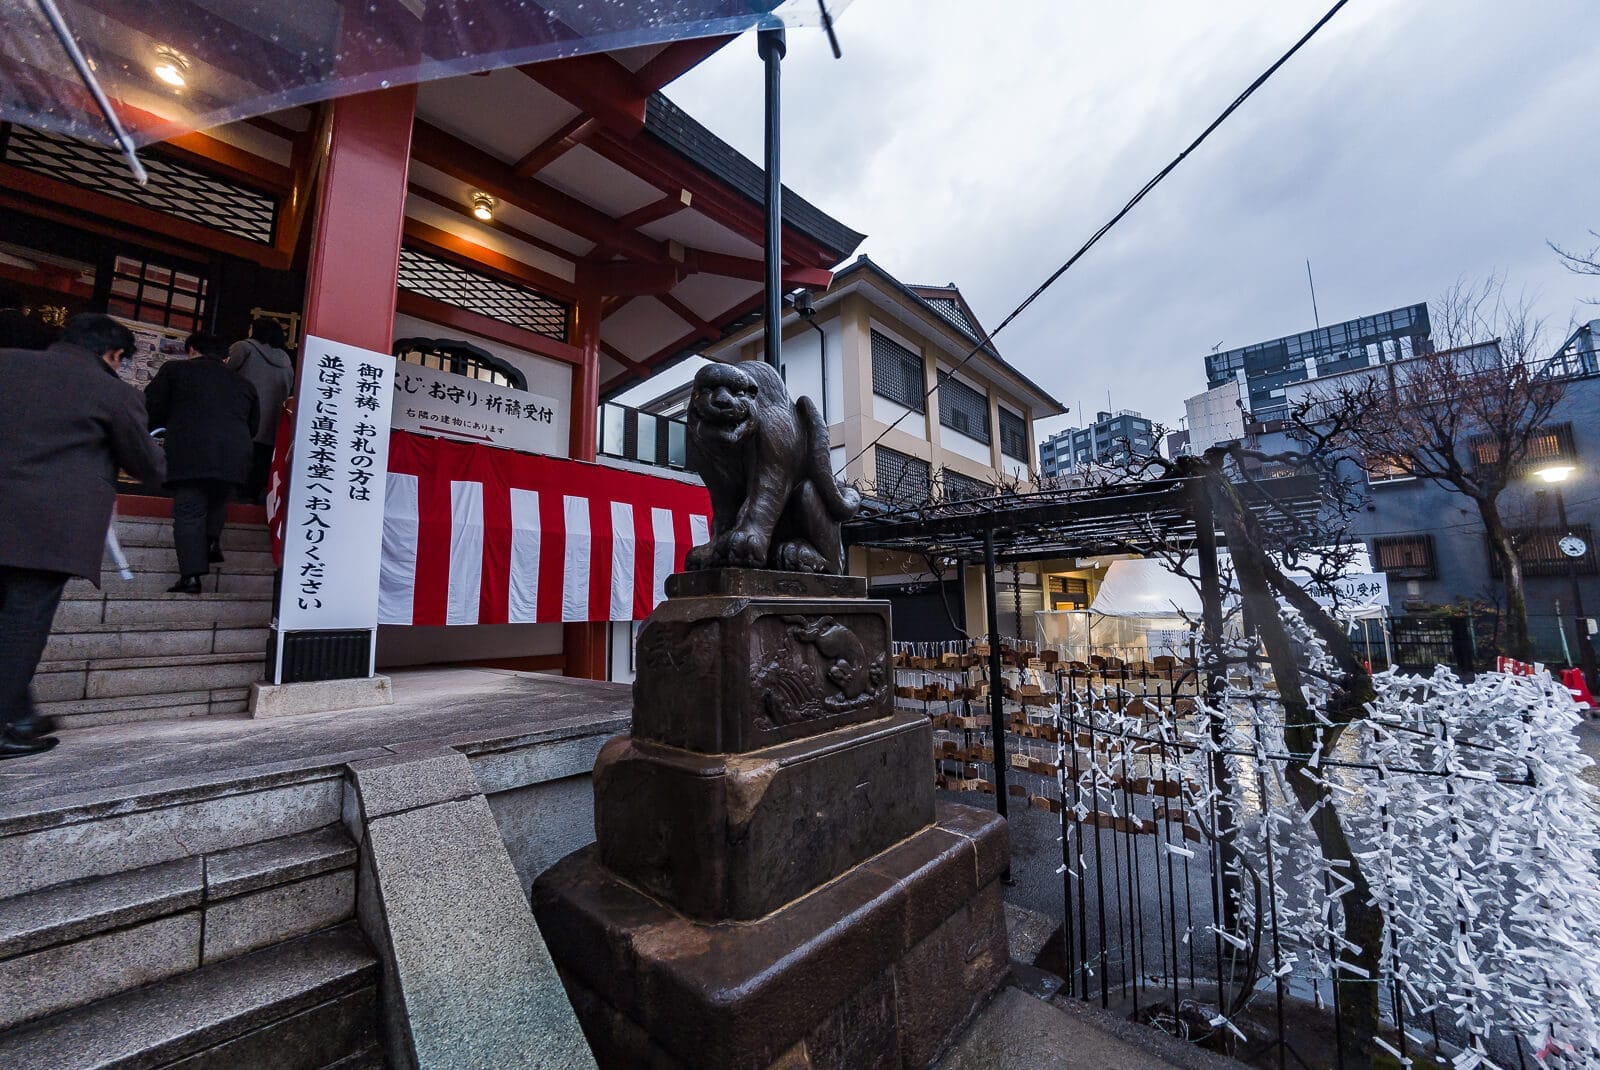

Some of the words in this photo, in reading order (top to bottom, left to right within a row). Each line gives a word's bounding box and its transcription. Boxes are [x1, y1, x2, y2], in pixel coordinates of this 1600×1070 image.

[297, 354, 346, 610] 並ばずに直接本堂へお入りください
[347, 362, 384, 502] 御祈祷・お札の方は
[405, 407, 505, 435] 右隣の建物にあります
